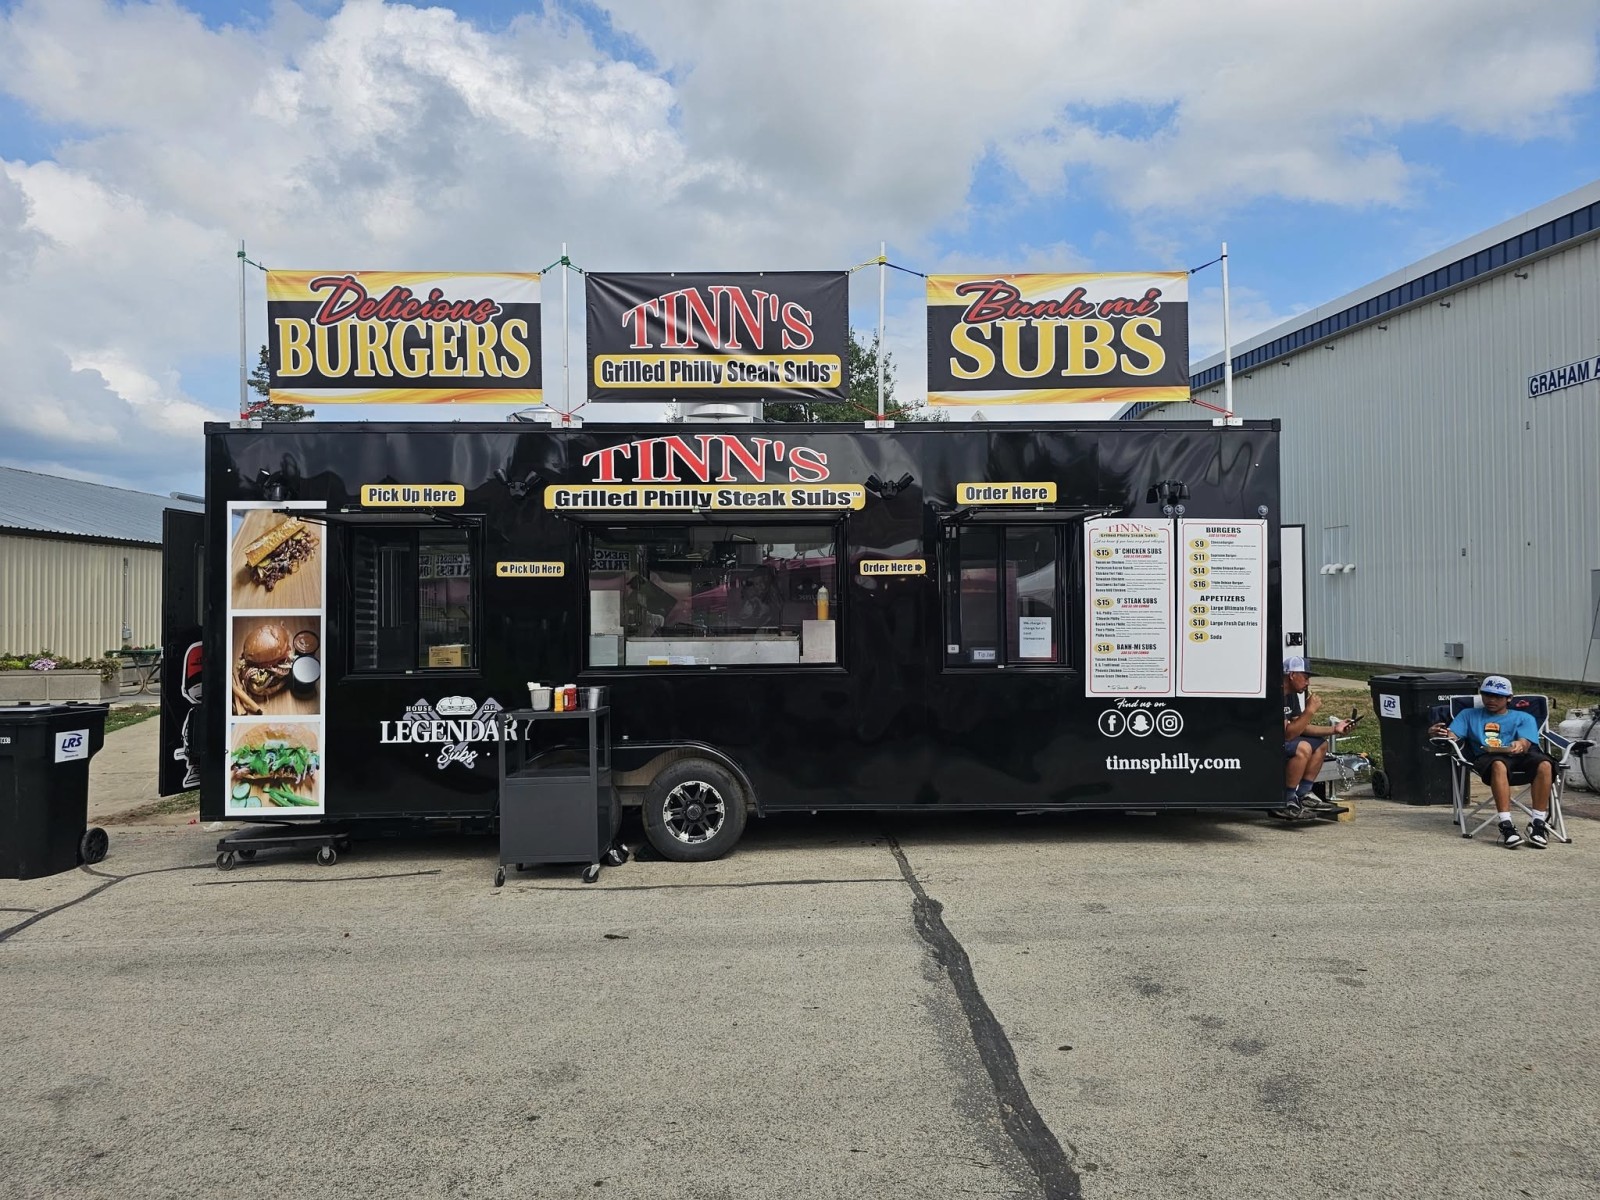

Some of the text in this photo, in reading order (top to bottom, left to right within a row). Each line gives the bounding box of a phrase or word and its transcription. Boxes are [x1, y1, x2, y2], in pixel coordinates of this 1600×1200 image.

[310, 275, 500, 325] Delicious
[1099, 288, 1162, 319] mi
[622, 286, 814, 350] TINN'S
[275, 318, 531, 378] BURGERS
[950, 317, 1166, 380] SUBS
[601, 360, 666, 383] Grilled
[670, 360, 723, 385] Philly
[727, 360, 780, 383] Steak
[1530, 361, 1590, 395] GRAHAM
[582, 434, 831, 483] TINN'S
[369, 488, 457, 503] Pick Up Here
[554, 489, 639, 507] Grilled
[643, 489, 712, 508] Philly
[717, 489, 787, 507] Steak
[965, 486, 1048, 501] Order Here
[509, 564, 562, 575] Pick Up Here
[863, 562, 913, 572] Order Here
[1114, 697, 1138, 709] Find
[1384, 699, 1396, 708] LRS
[62, 736, 83, 749] LRS
[437, 744, 478, 764] Subs
[1105, 752, 1241, 774] tinnsphilly.com
